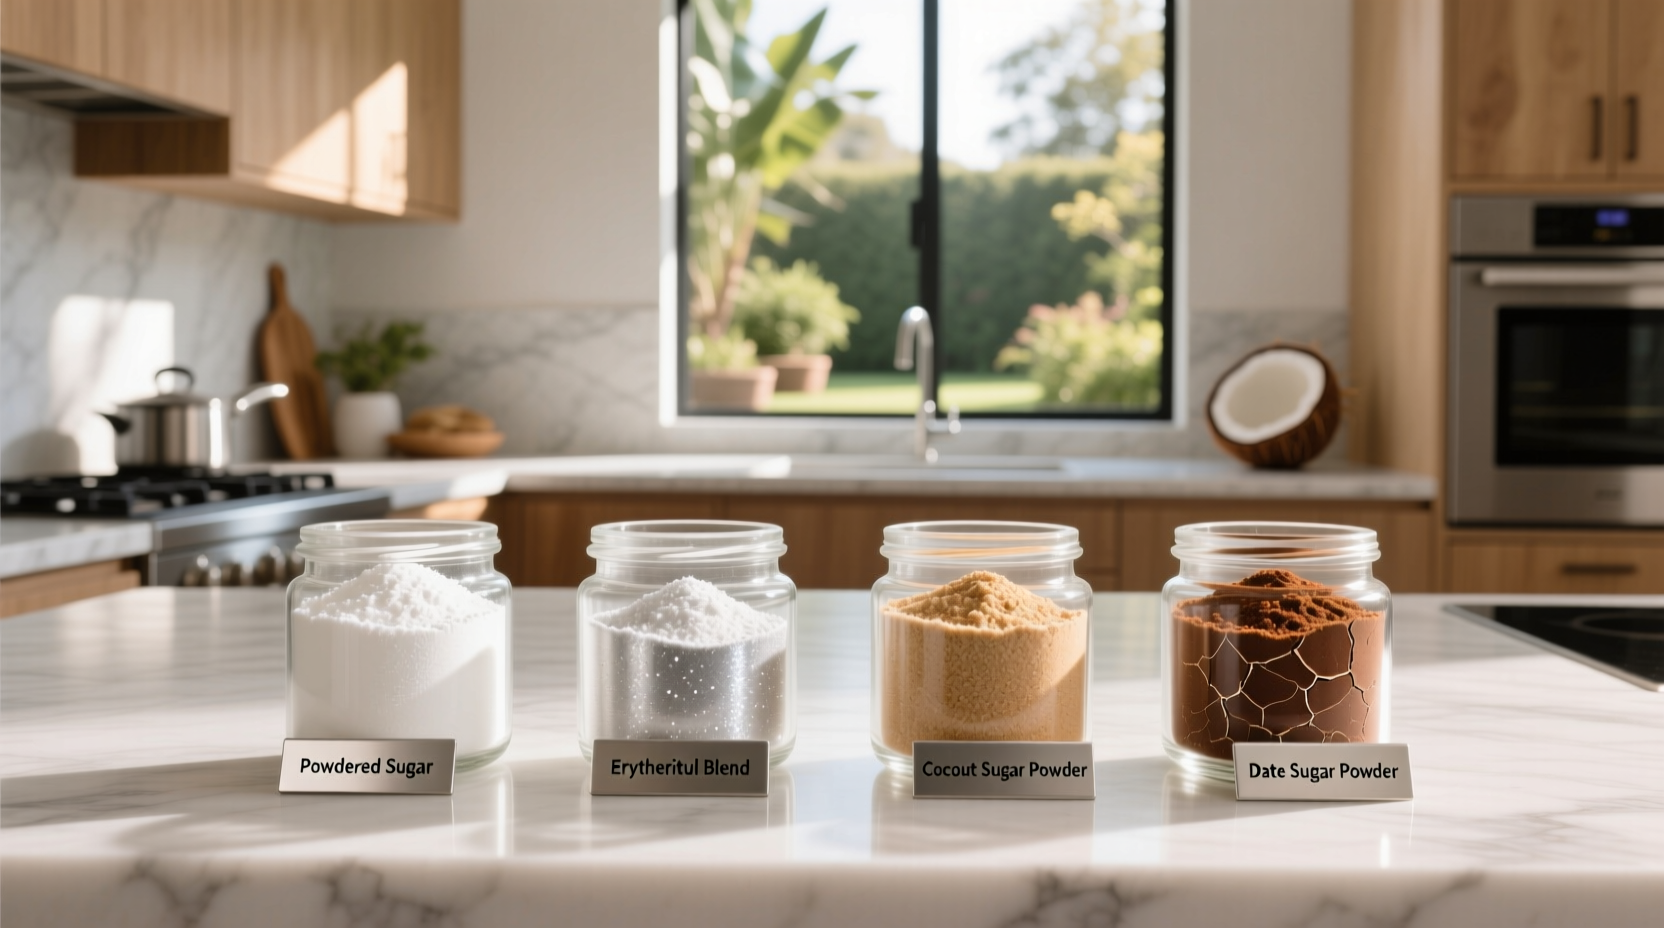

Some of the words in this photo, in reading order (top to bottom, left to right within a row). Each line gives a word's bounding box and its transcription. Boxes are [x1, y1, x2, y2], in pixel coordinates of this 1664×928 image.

[300, 757, 381, 774] Powdered
[385, 758, 434, 779] Sugar
[611, 758, 698, 779] Erytheritul
[704, 758, 750, 776] Blend
[922, 761, 977, 777] Cocout
[981, 761, 1026, 782] Sugar
[1029, 761, 1088, 777] Powder
[1249, 763, 1286, 778] Date
[1290, 763, 1336, 783] Sugar
[1340, 763, 1399, 779] Powder
